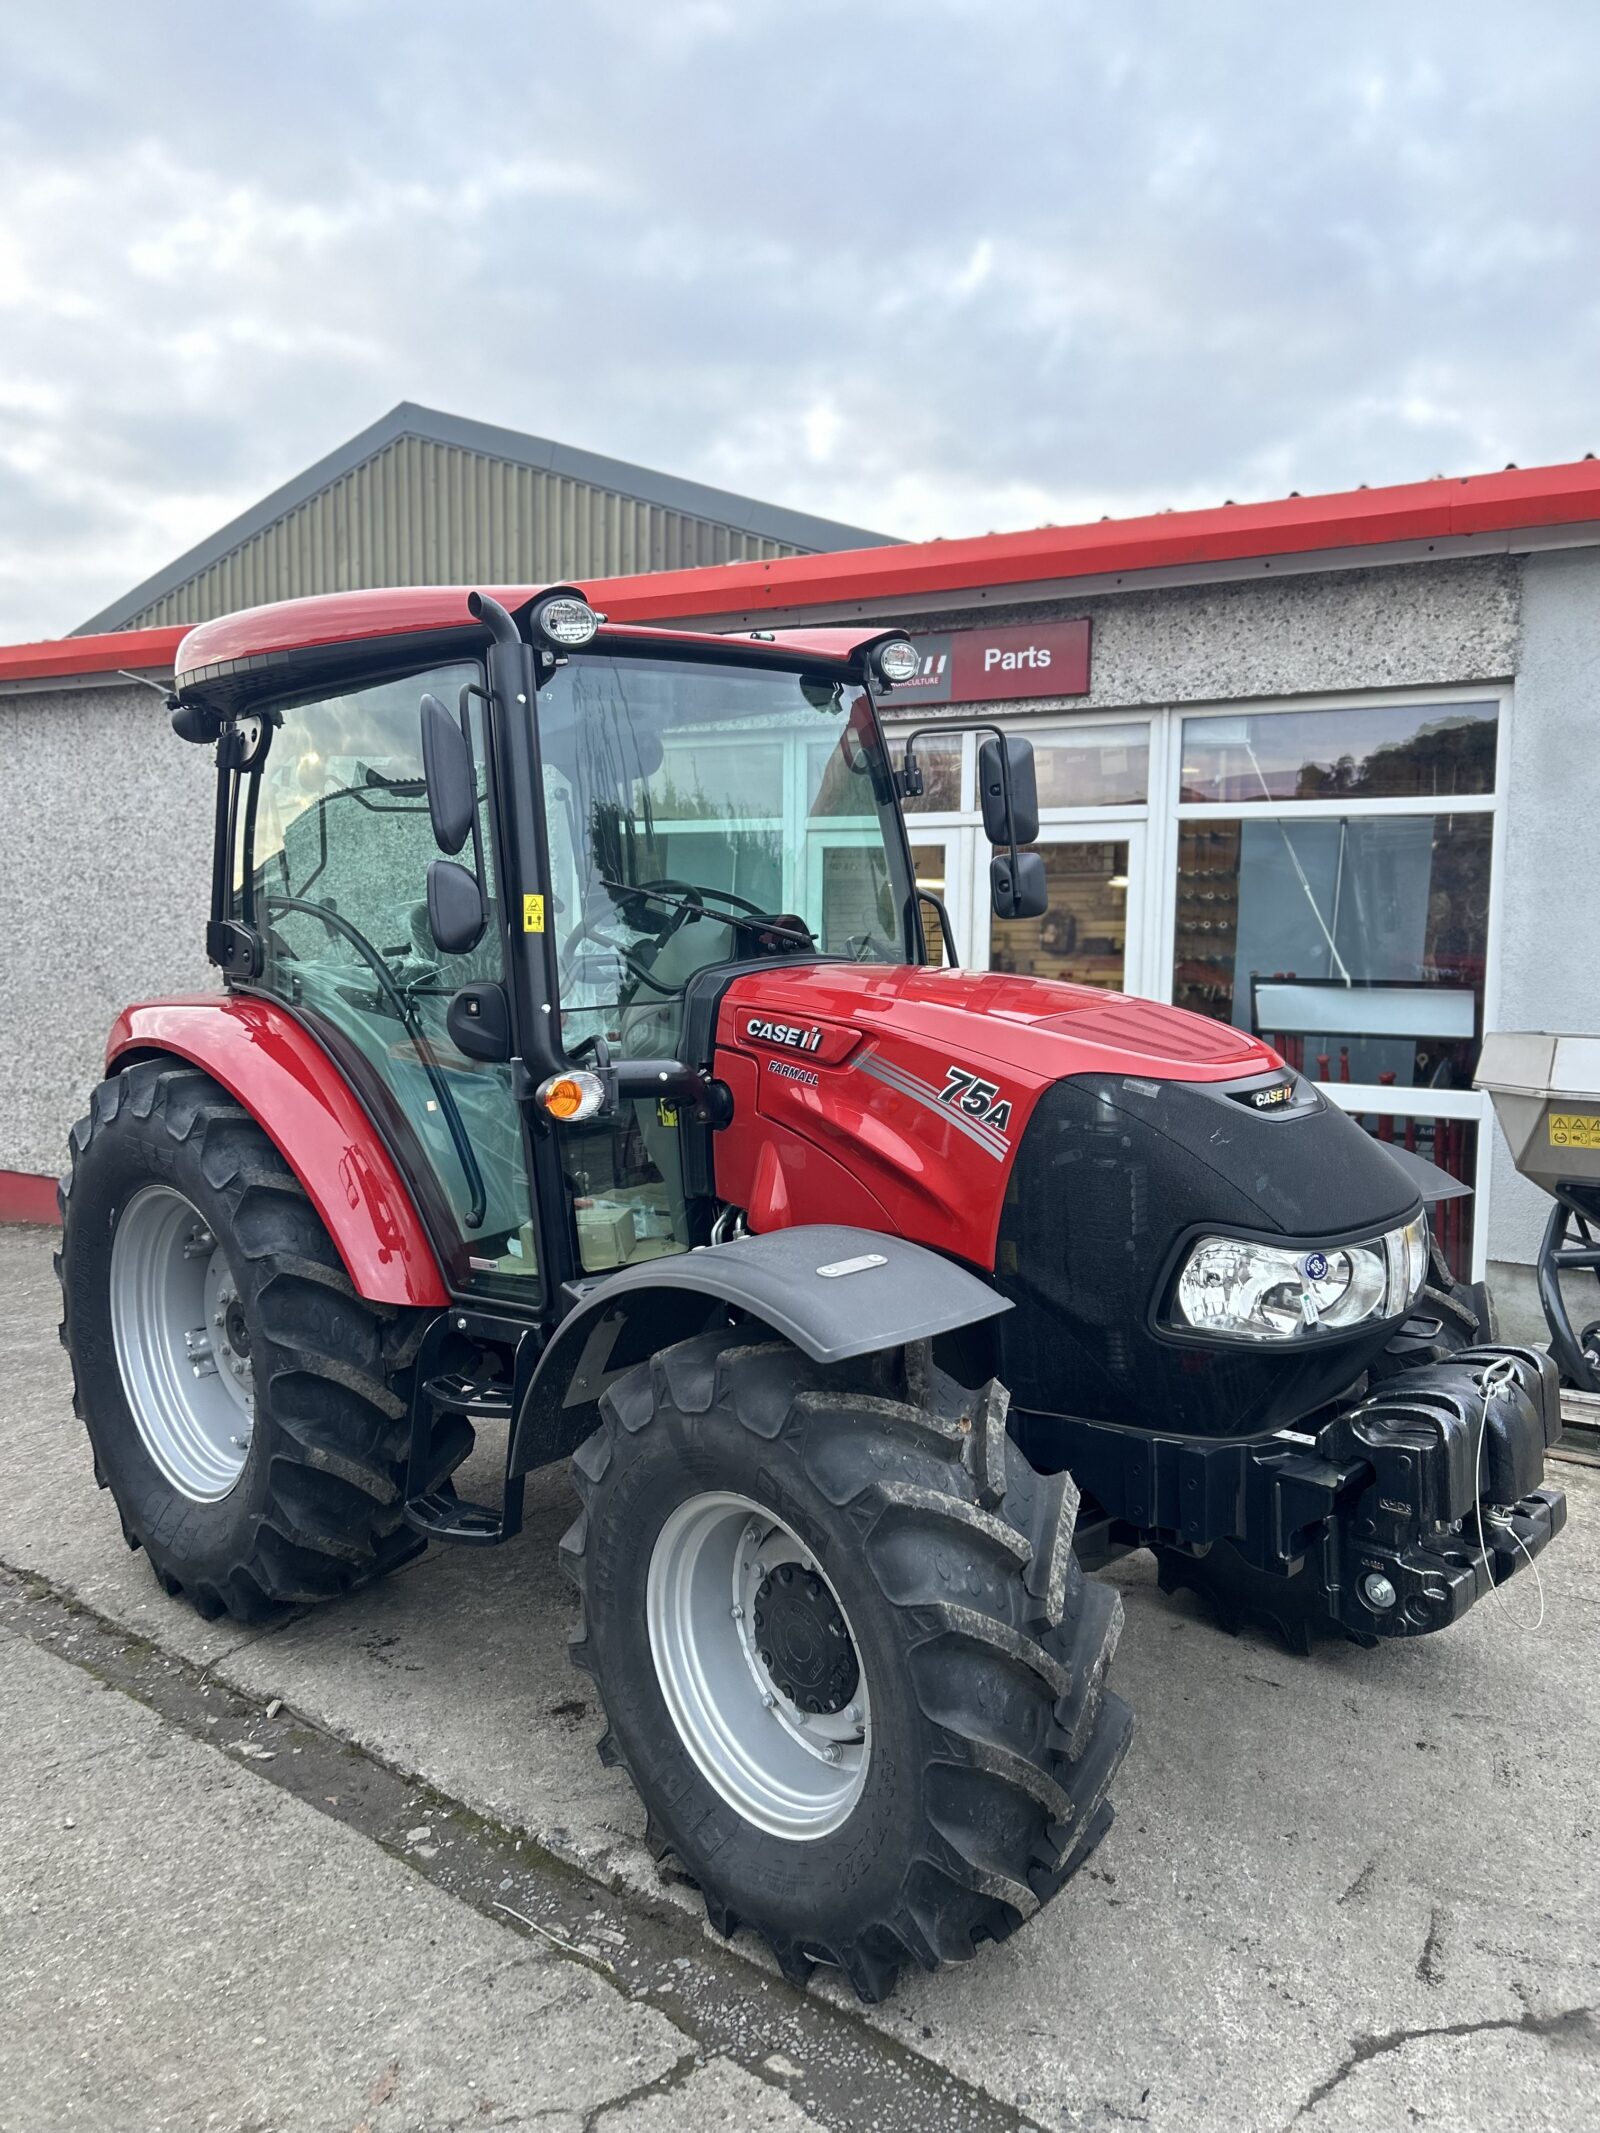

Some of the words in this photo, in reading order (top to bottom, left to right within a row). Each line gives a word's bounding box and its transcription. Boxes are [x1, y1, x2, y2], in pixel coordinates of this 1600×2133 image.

[984, 646, 1051, 671] Parts
[747, 1019, 801, 1046] CASE
[768, 1060, 819, 1086] FARMALL
[937, 1065, 1012, 1132] 75A
[1256, 1089, 1283, 1106] CASE
